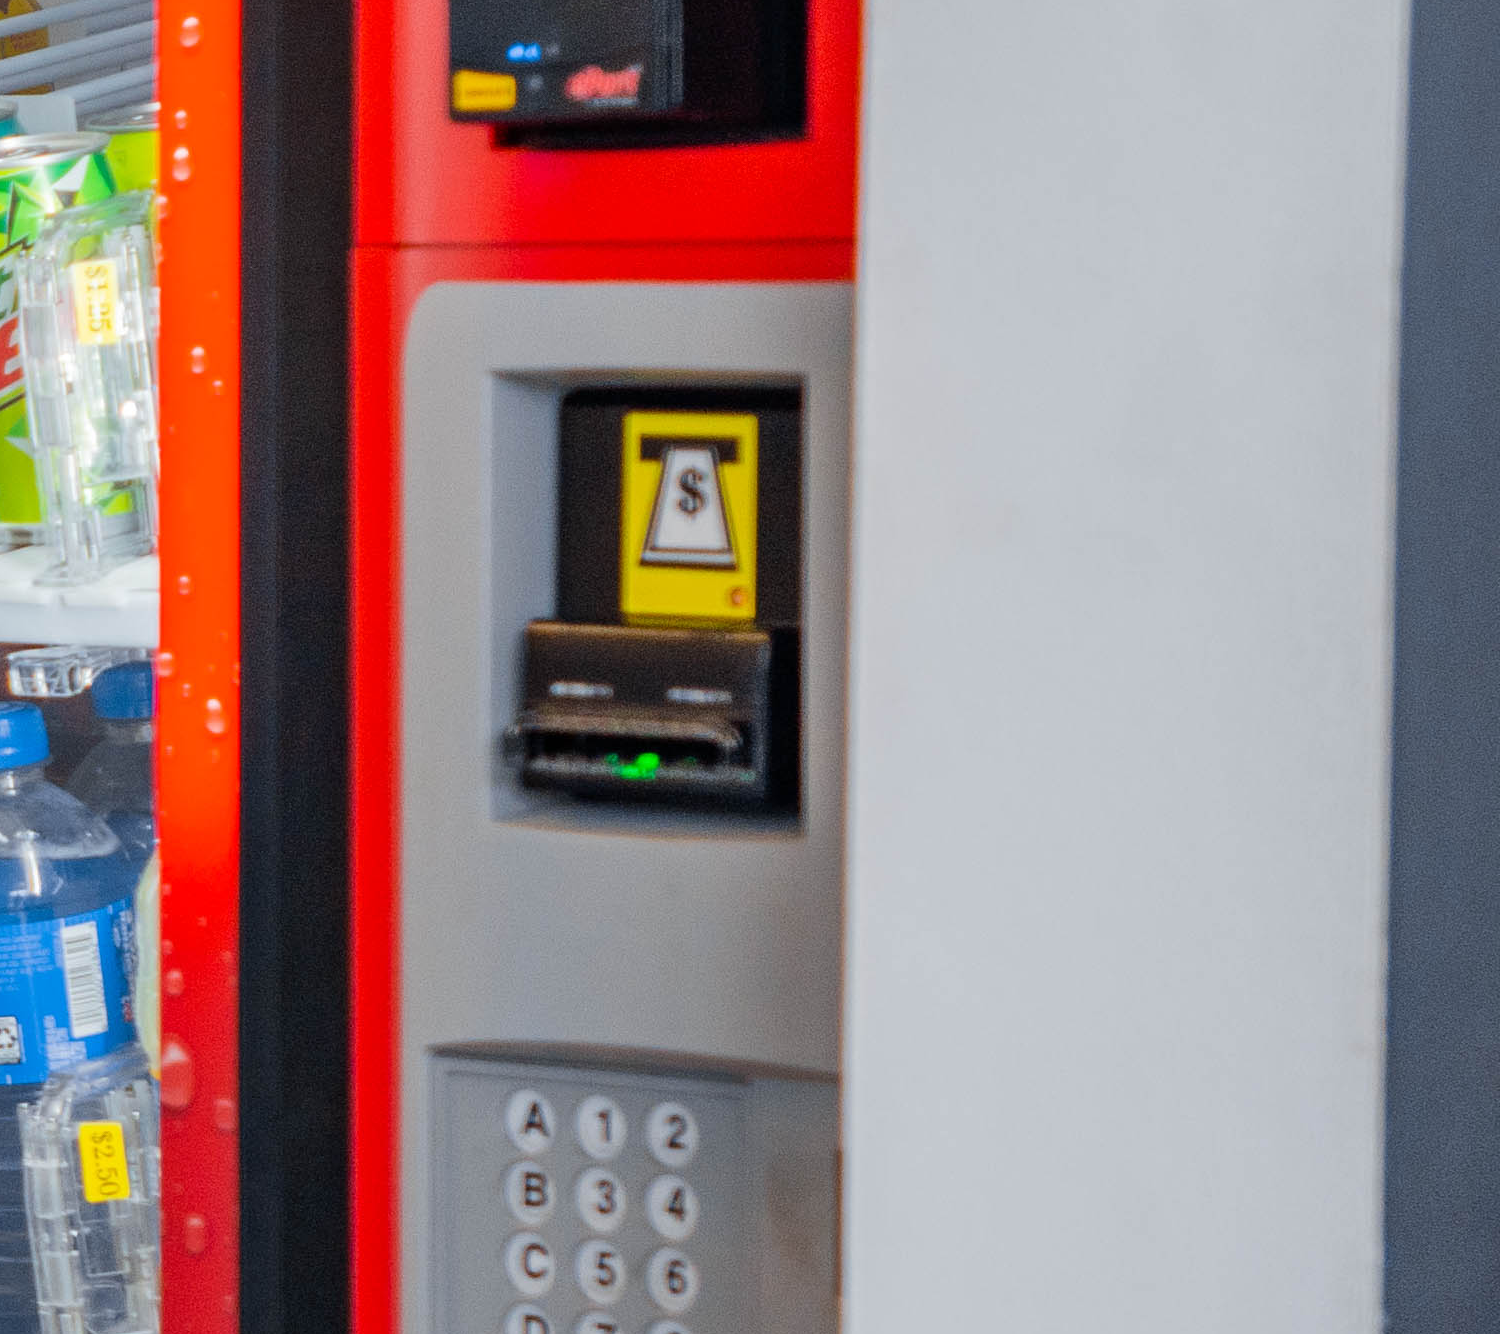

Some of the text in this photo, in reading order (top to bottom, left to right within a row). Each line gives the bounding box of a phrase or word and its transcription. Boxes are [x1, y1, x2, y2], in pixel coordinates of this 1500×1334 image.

[521, 1101, 687, 1149] A 1 2
[94, 1132, 122, 1198] $2.50
[523, 1170, 687, 1222] B 3 4
[521, 1242, 687, 1295] C 5 6
